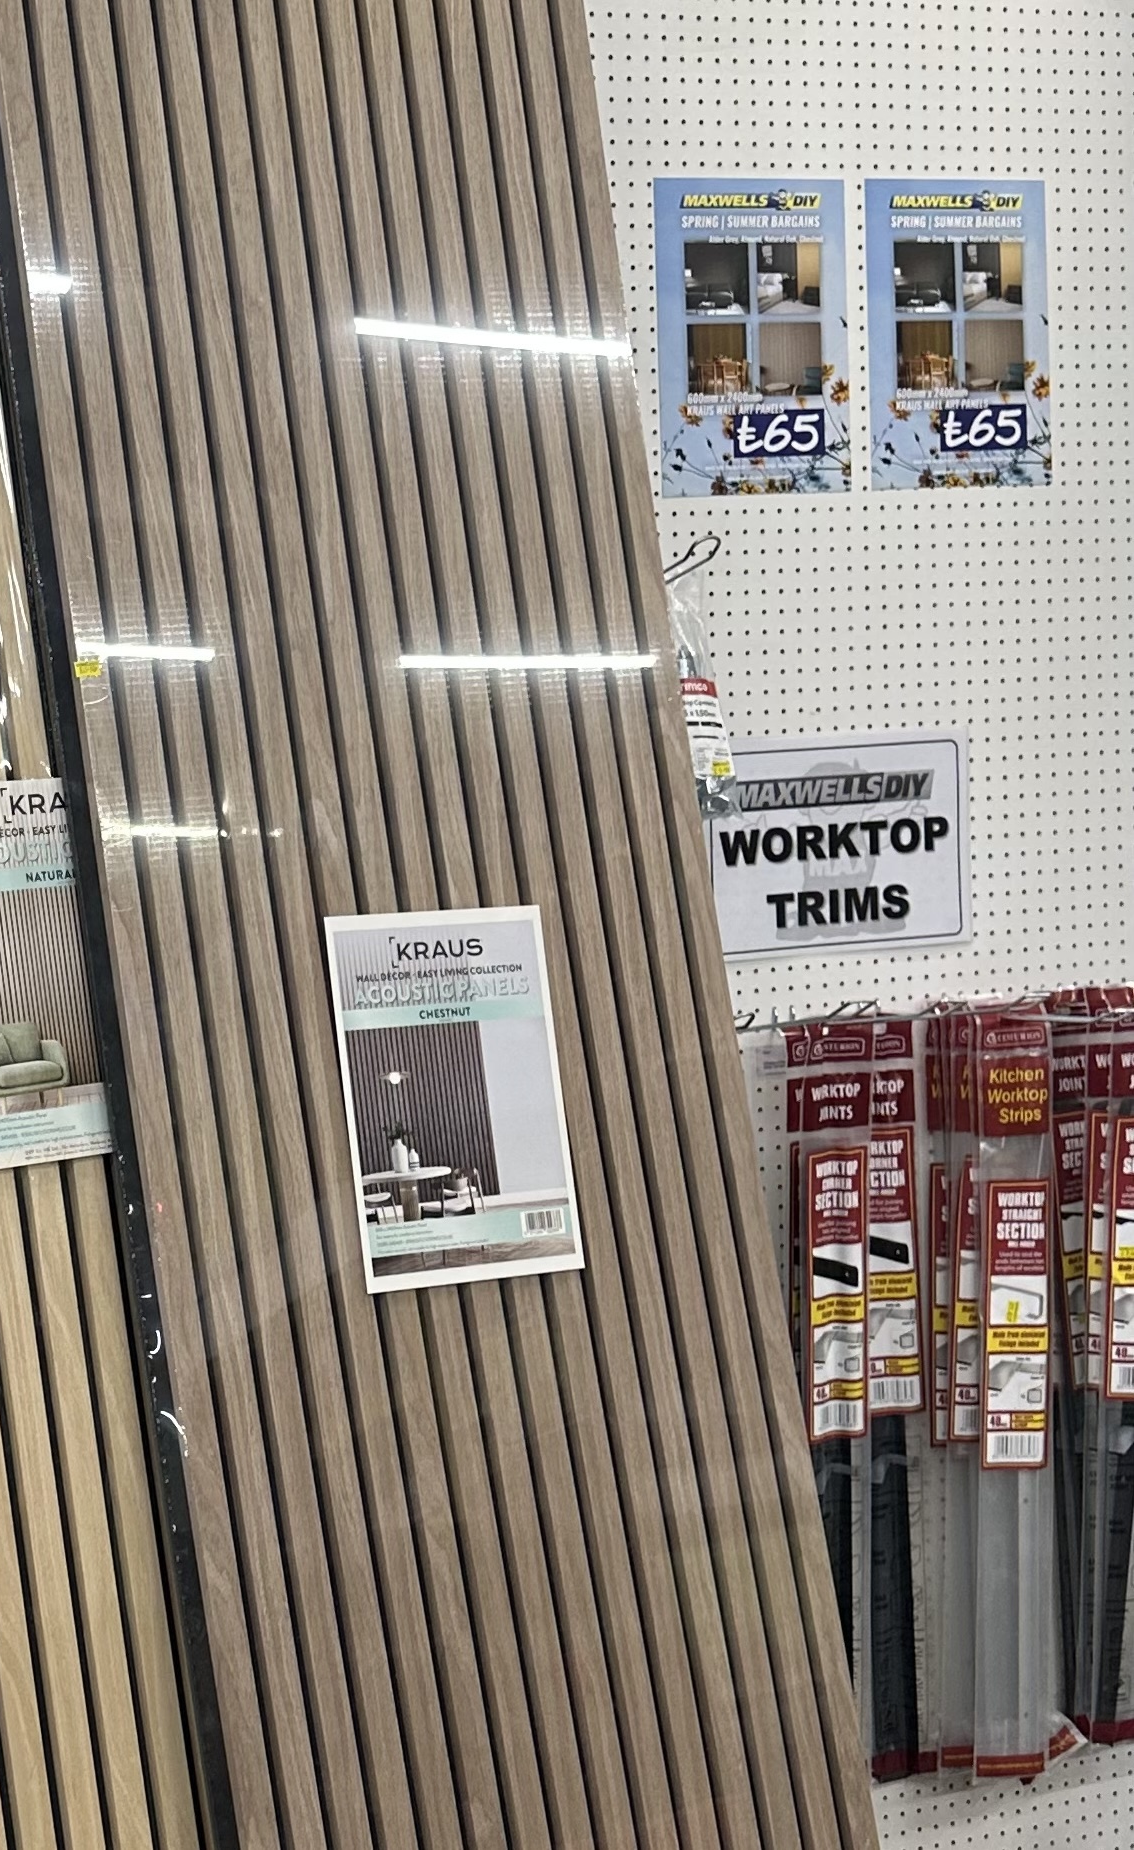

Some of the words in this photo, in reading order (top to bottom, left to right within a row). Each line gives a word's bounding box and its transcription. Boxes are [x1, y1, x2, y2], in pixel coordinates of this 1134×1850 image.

[683, 194, 768, 207] MAXWELLS
[793, 195, 819, 207] DIY
[891, 195, 974, 208] MAXWELLS
[996, 196, 1020, 207] DIY
[681, 215, 719, 228] SPRING
[727, 215, 770, 228] SUMMER
[771, 215, 821, 228] BARGAINS
[891, 215, 926, 228] SPRING
[934, 215, 973, 228] SUMMER
[975, 215, 1022, 228] BARGAINS
[687, 392, 718, 404] 600mm
[727, 392, 764, 403] 2400mm
[896, 388, 928, 399] 600mm
[934, 387, 968, 398] 2400mm
[687, 405, 714, 416] KRAUS
[717, 404, 737, 416] WALL
[738, 403, 755, 415] ART
[755, 403, 784, 415] PANELS
[896, 400, 922, 410] KRAUS
[924, 400, 942, 410] WALL
[961, 399, 989, 409] PANELS
[737, 776, 883, 810] MAXWELLS
[884, 771, 930, 798] DIY
[9, 792, 68, 815] KRA
[32, 825, 56, 836] EASY
[719, 816, 949, 867] WORKTOP
[766, 884, 910, 929] TRIMS
[396, 938, 483, 961] KRAUS
[356, 974, 379, 983] WALL
[417, 969, 438, 979] EASY
[440, 967, 468, 978] LIVING
[470, 964, 522, 976] COLLECTION
[355, 981, 456, 1006] ACOUSTIC
[456, 976, 530, 1001] PANELS
[419, 1007, 471, 1019] CHESTNUT
[1053, 1055, 1085, 1071] WORKT
[989, 1067, 1045, 1084] Kitchen
[811, 1082, 861, 1101] WRKTOP
[987, 1087, 1048, 1104] Worktop
[999, 1107, 1042, 1126] Strips
[815, 1191, 859, 1211] SECTION
[1002, 1208, 1042, 1221] STRAIGHT
[997, 1222, 1045, 1240] SECTION
